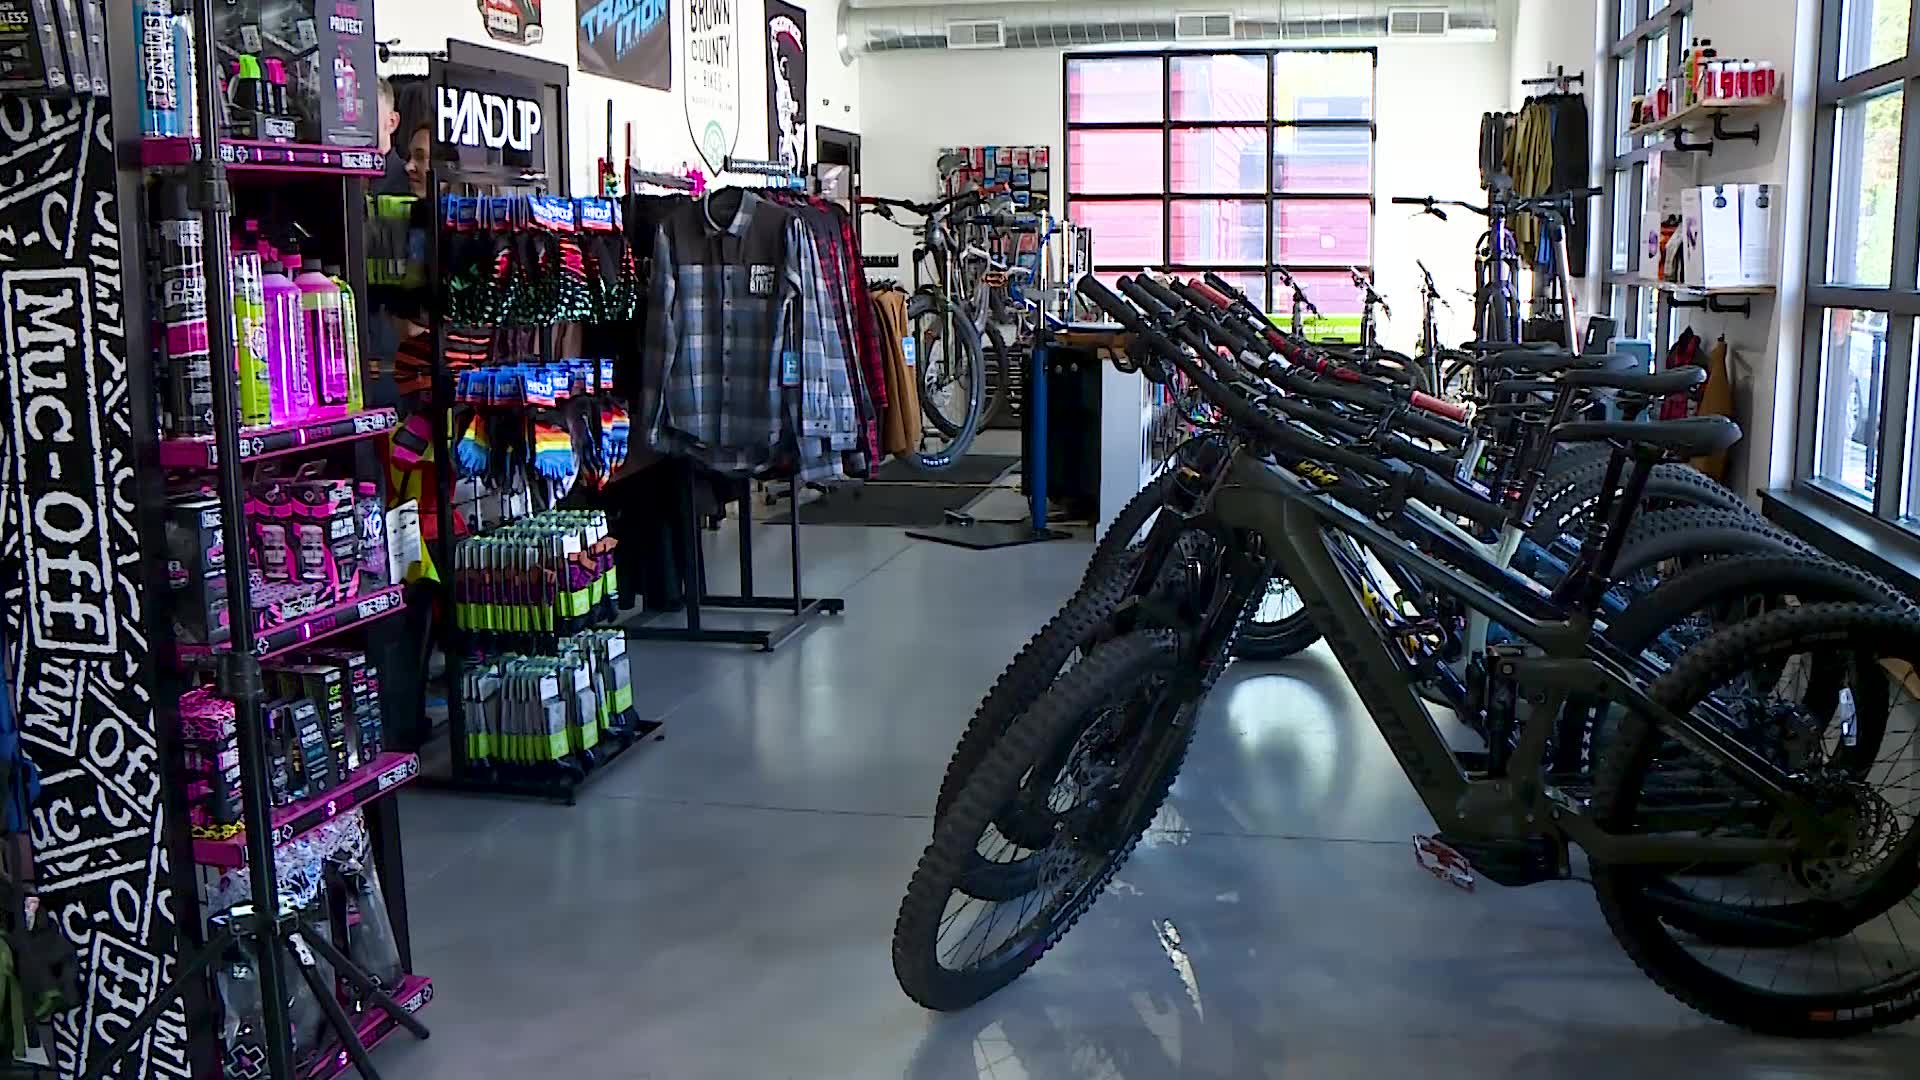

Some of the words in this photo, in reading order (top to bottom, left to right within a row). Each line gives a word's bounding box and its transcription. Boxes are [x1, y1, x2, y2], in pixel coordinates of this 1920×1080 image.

[330, 16, 364, 34] PROTECT
[690, 0, 731, 32] BROWN
[691, 34, 732, 69] COUNTY
[437, 85, 542, 152] HANDUP
[15, 288, 105, 636] Muc-Off
